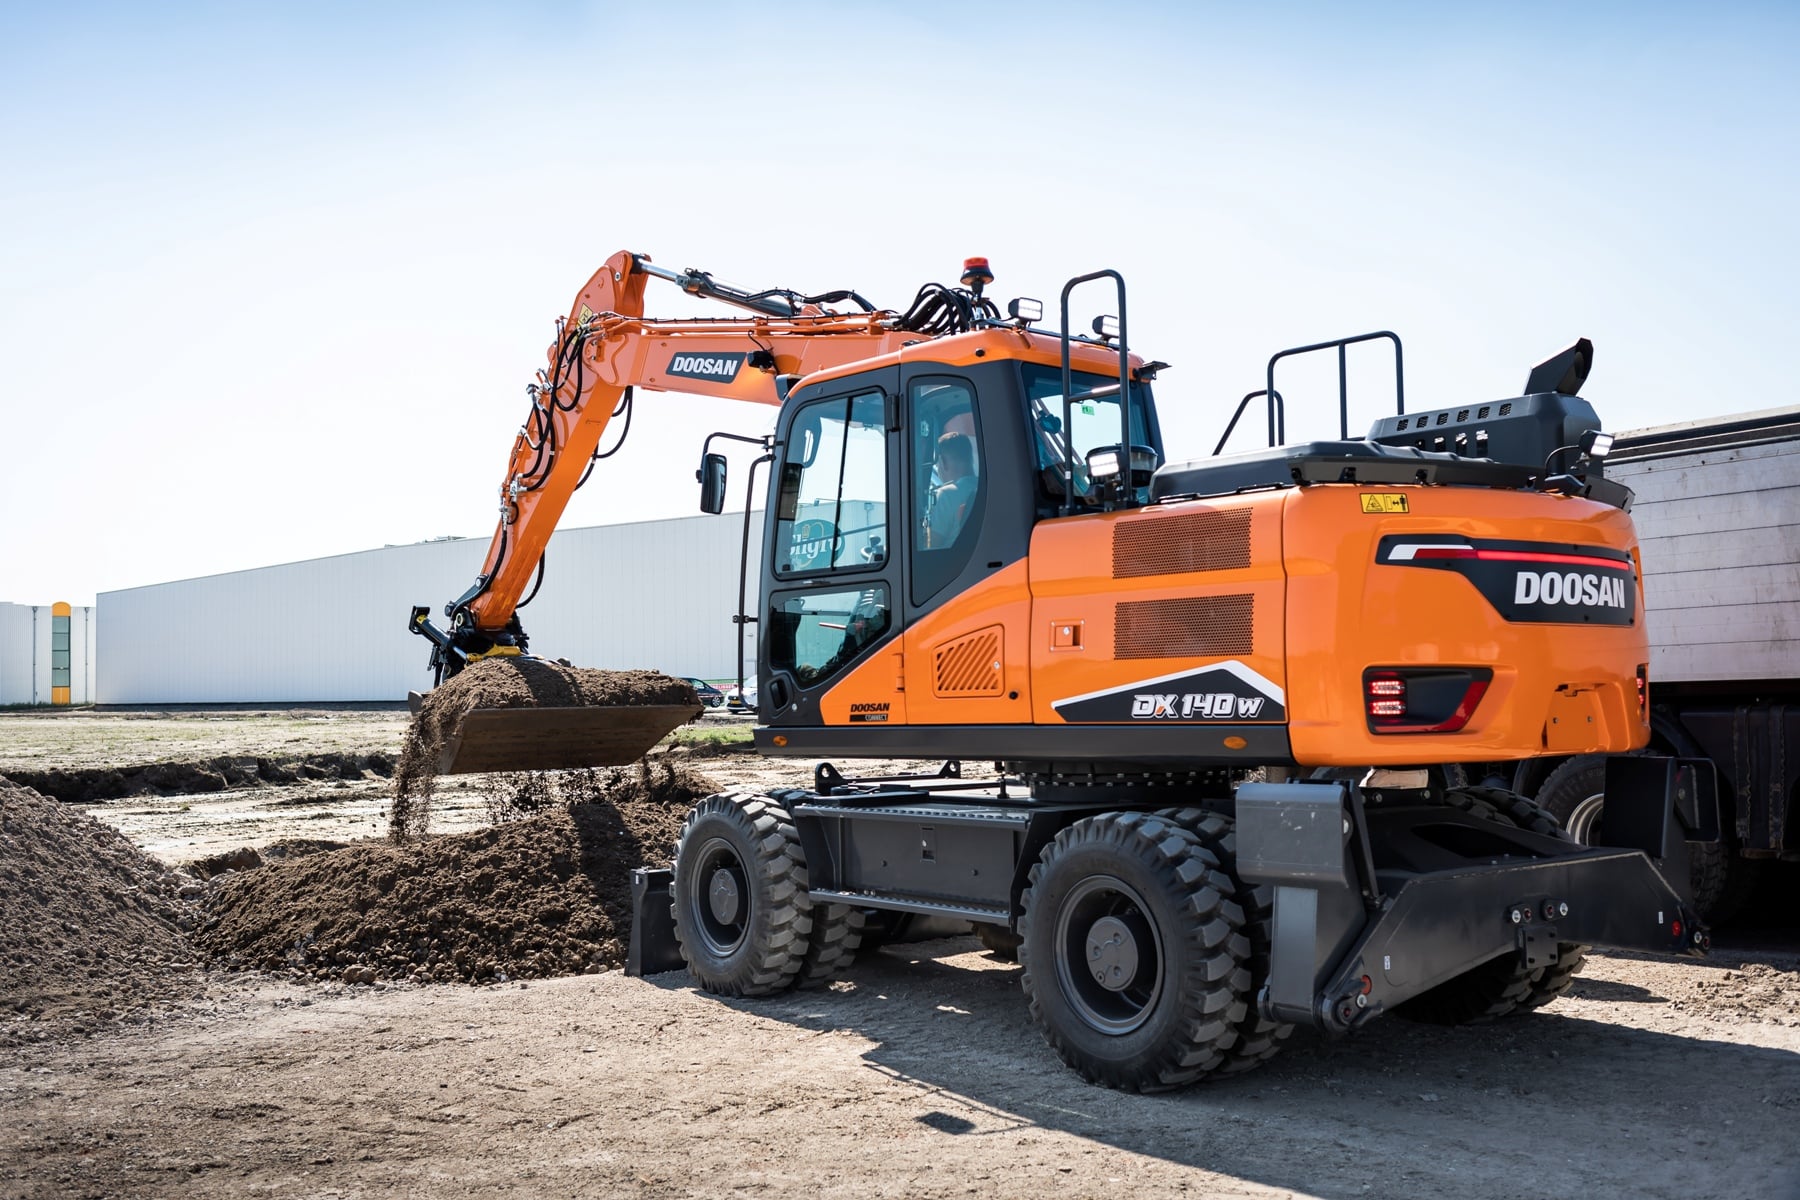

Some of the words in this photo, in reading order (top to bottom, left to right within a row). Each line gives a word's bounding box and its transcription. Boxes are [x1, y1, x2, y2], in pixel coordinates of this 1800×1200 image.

[672, 356, 738, 376] DOOSAN
[1514, 571, 1626, 609] DOOSAN
[850, 703, 890, 713] DOOSAN
